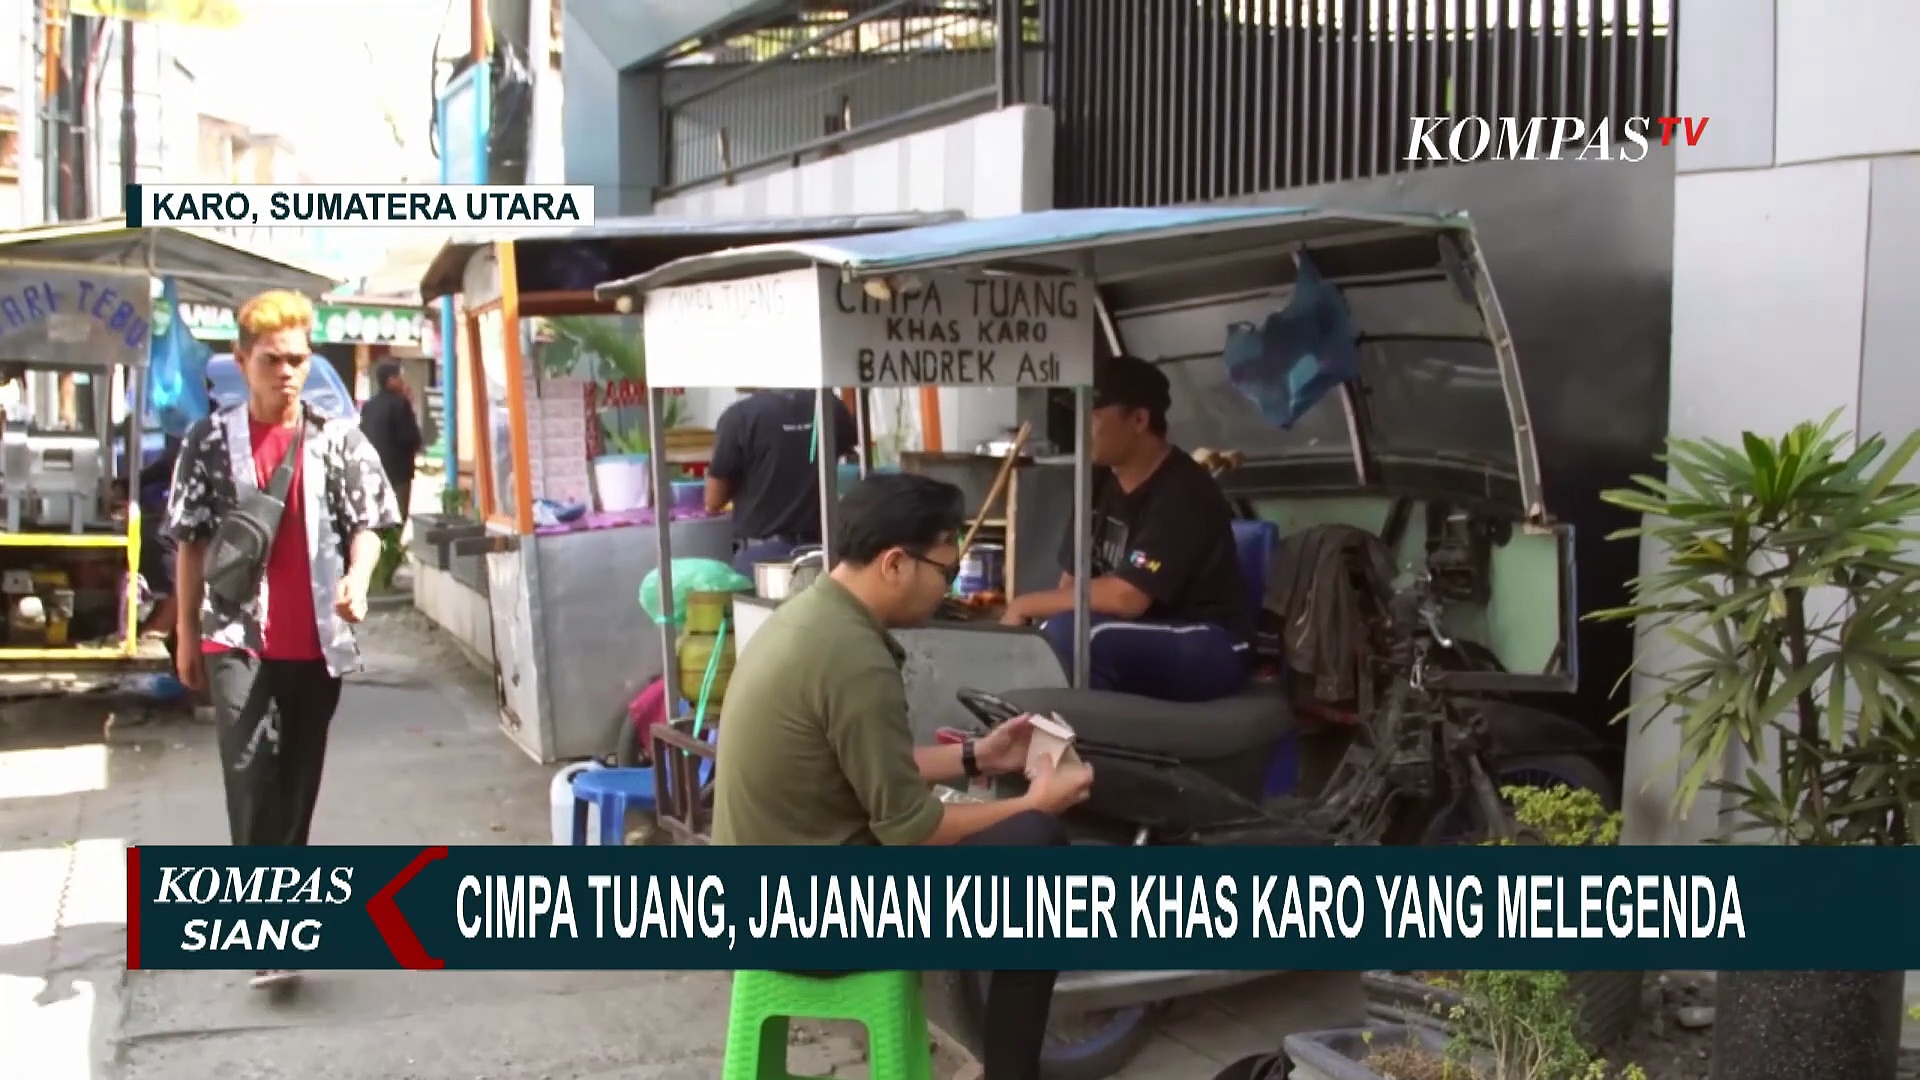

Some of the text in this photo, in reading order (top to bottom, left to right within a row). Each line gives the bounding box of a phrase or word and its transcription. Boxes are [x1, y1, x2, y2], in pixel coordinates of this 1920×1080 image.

[0, 280, 148, 347] ARI TEBU
[964, 279, 1078, 318] TUANG
[887, 317, 1047, 343] KHAS KARO
[859, 348, 1060, 383] BANDREK Asli
